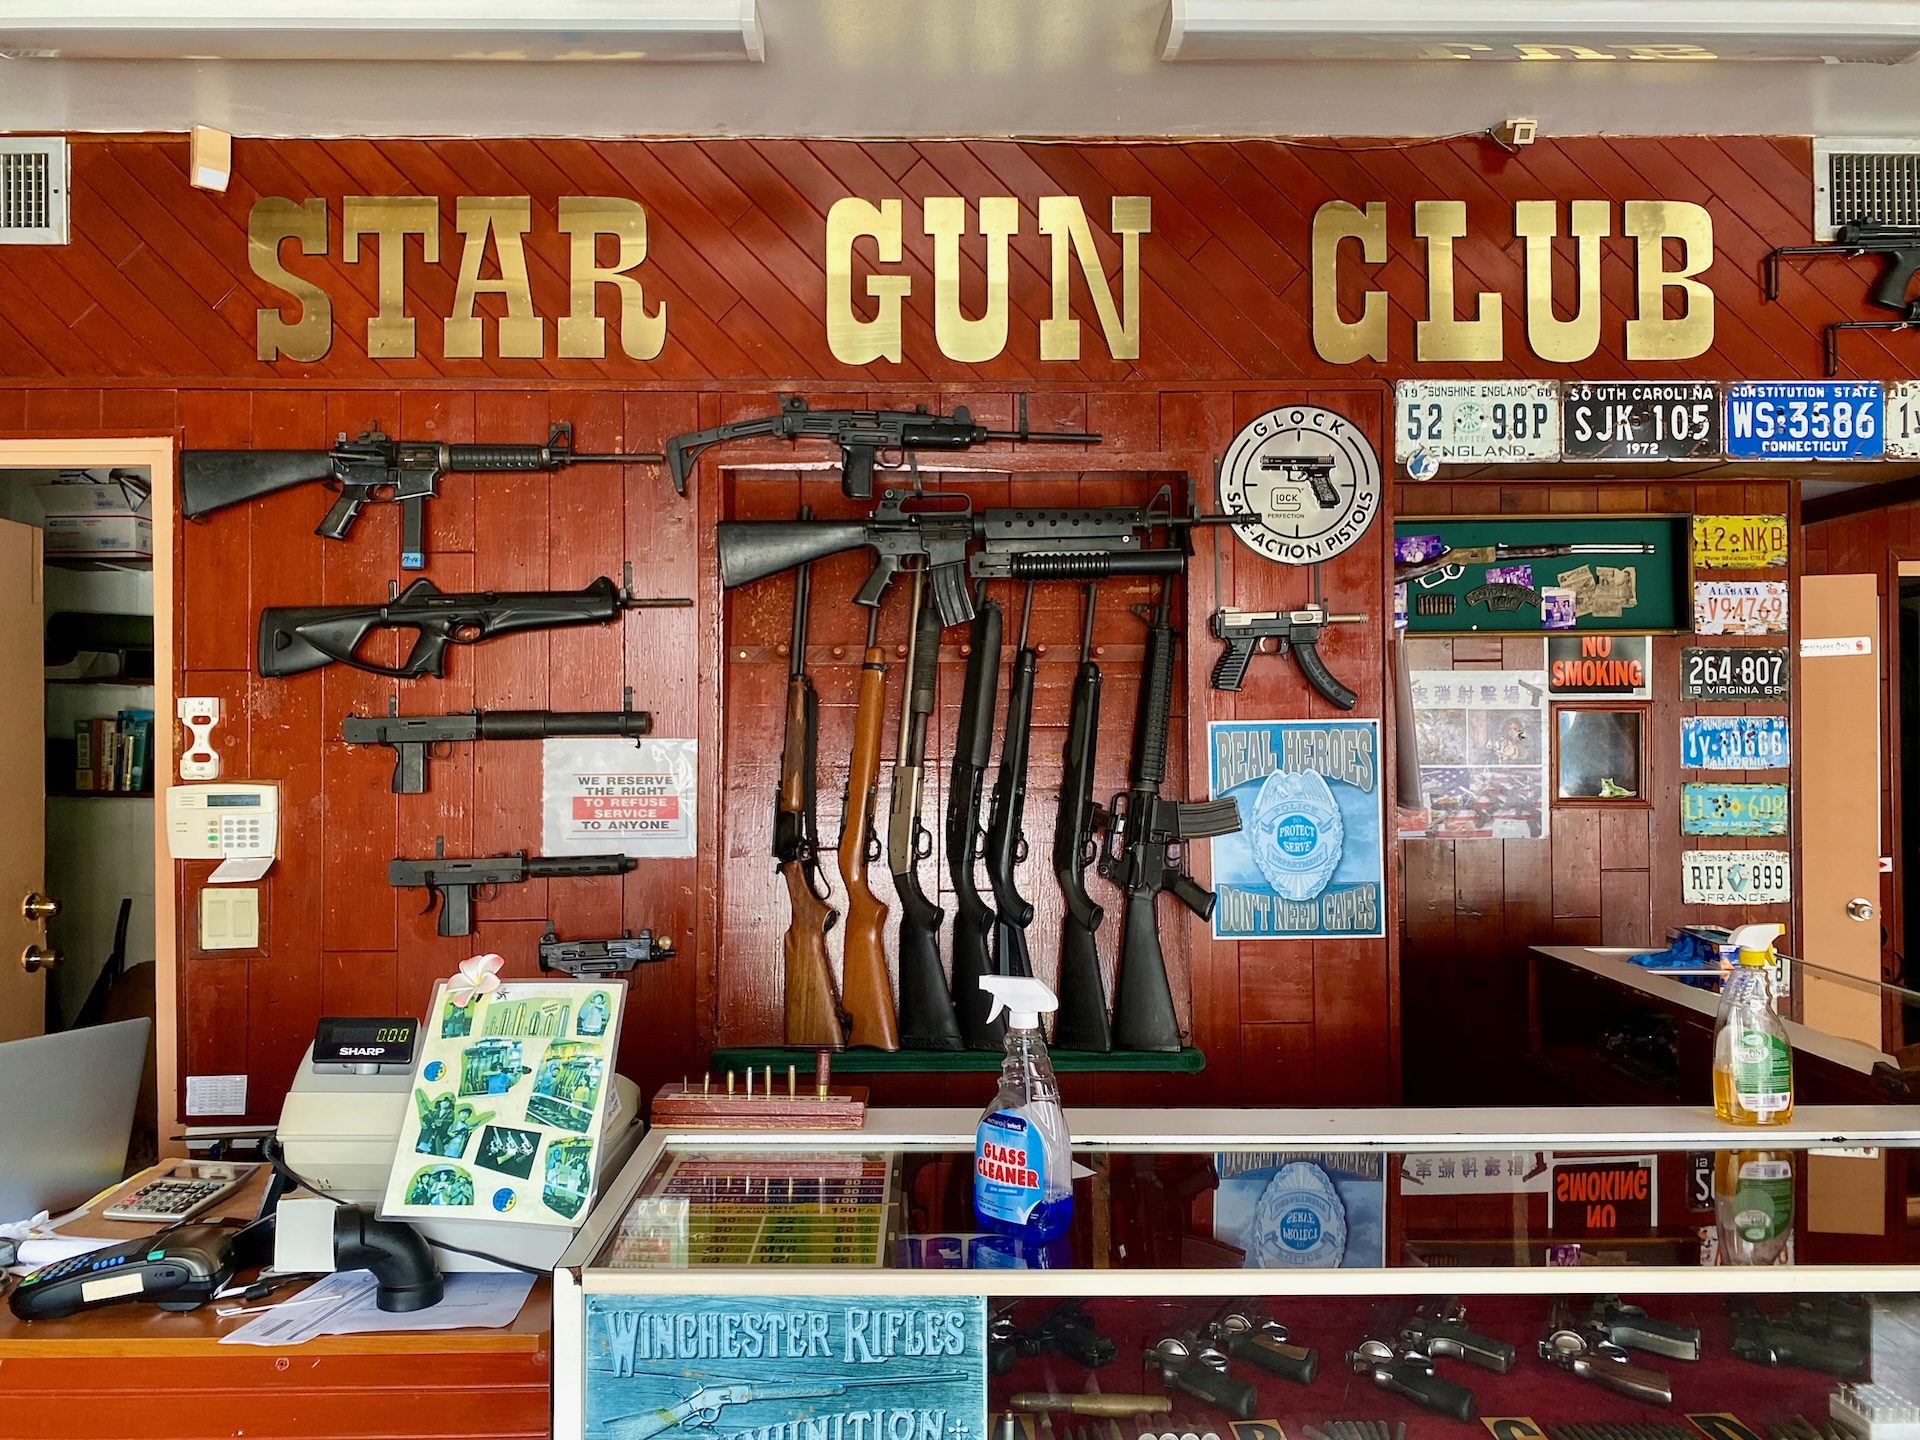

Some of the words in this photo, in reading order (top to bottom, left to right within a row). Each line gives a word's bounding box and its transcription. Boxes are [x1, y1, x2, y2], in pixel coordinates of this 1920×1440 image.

[248, 195, 667, 362] STAR
[825, 195, 1153, 365] GUN
[1311, 200, 1715, 364] CLUB
[1428, 387, 1476, 397] SUNSHINE
[1482, 386, 1528, 397] ENGLAND
[1632, 387, 1714, 401] CAROLINA
[1732, 386, 1825, 398] CONSTITUTION
[1834, 386, 1878, 398] STATE
[1253, 410, 1346, 438] GLOCK
[1407, 403, 1443, 440] 52
[1492, 403, 1548, 440] 98P
[1574, 405, 1634, 442] SJK
[1653, 404, 1710, 441] 105
[1429, 445, 1526, 457] ENGLAND
[1626, 443, 1659, 455] 1972
[1761, 440, 1849, 452] CONNECTICUT
[1226, 491, 1323, 560] SAE-ACTION
[1325, 491, 1374, 552] PISTOLS
[1743, 526, 1783, 551] NKB
[1709, 586, 1760, 596] ALABAMA
[1708, 597, 1783, 620] V94769
[1582, 636, 1612, 658] NO
[1835, 642, 1851, 652] Only
[1552, 660, 1643, 687] SMOKING
[1689, 686, 1702, 694] 19
[1707, 686, 1760, 694] VIRGINIA
[1216, 730, 1278, 796] REAL
[1282, 728, 1374, 792] HEROES
[578, 776, 600, 785] WE
[607, 776, 674, 785] RESERVE
[586, 787, 614, 795] THE
[621, 787, 667, 796] RIGHT
[584, 798, 604, 807] TO
[610, 798, 668, 807] REFUSE
[1272, 803, 1319, 815] POLICE
[1748, 794, 1784, 819] 608
[594, 809, 657, 818] SERVICE
[582, 821, 601, 829] TO
[608, 820, 670, 829] ANYONE
[1279, 824, 1315, 837] PROTECT
[1283, 841, 1312, 852] SERVE
[1272, 852, 1324, 868] DEPARTMENT
[1691, 866, 1723, 889] RFI
[1753, 866, 1783, 889] 899
[1707, 893, 1769, 902] FRANCE
[1219, 884, 1271, 932] DON'T
[1274, 897, 1320, 931] NEED
[1323, 883, 1377, 931] CAPES
[376, 1028, 409, 1042] 0.00
[339, 1047, 385, 1056] SHARP
[983, 1142, 1026, 1167] GLASS
[977, 1158, 1038, 1188] CLEANER
[606, 1310, 834, 1378] WINCHESTER
[843, 1307, 966, 1365] RIFLES
